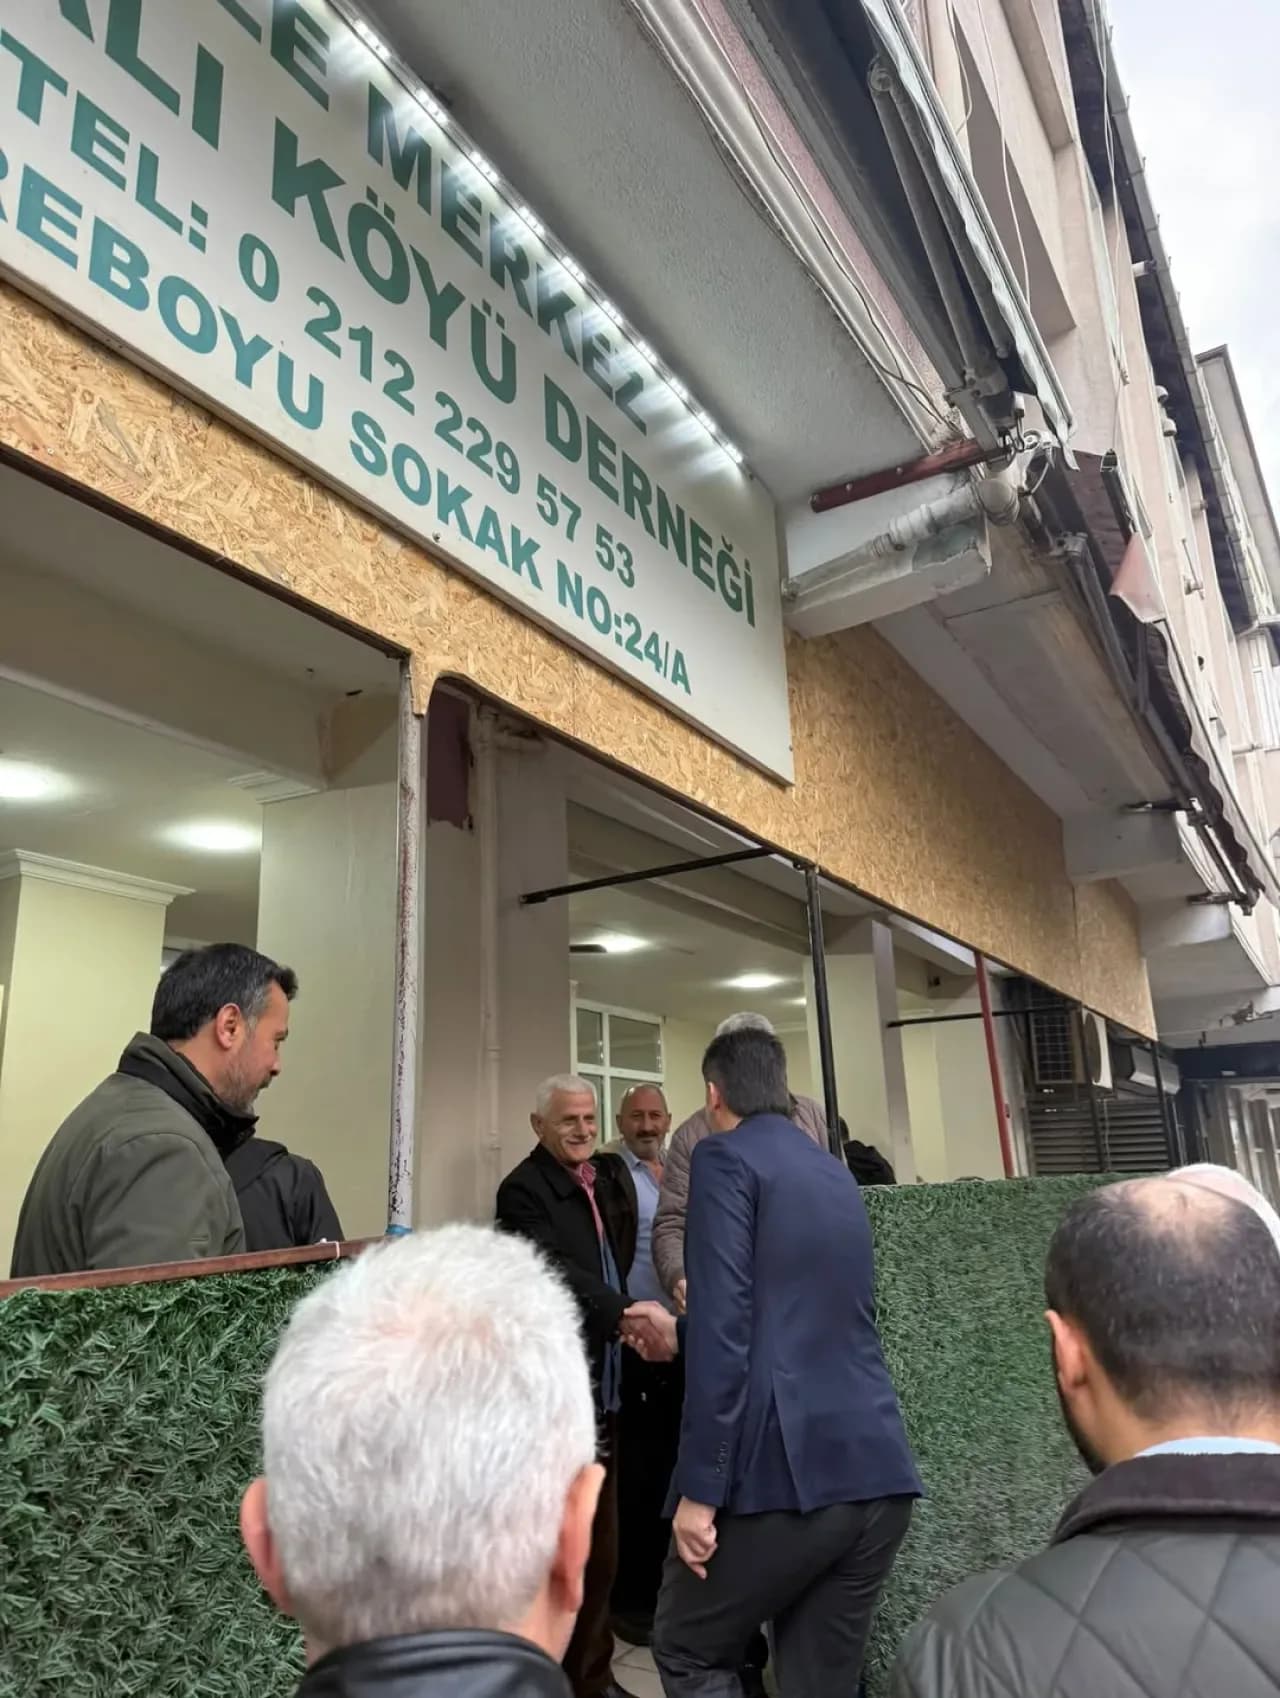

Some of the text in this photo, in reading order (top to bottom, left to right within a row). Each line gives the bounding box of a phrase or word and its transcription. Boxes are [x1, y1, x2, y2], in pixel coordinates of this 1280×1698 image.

[0, 27, 635, 588] TEL: 0 212 229 57 53
[271, 116, 517, 404] KÖYÜ
[543, 373, 755, 627] DERNEĞİ
[368, 80, 647, 436] MERKEZ
[349, 410, 543, 591] SOKAK
[556, 559, 691, 694] NO:24/A
